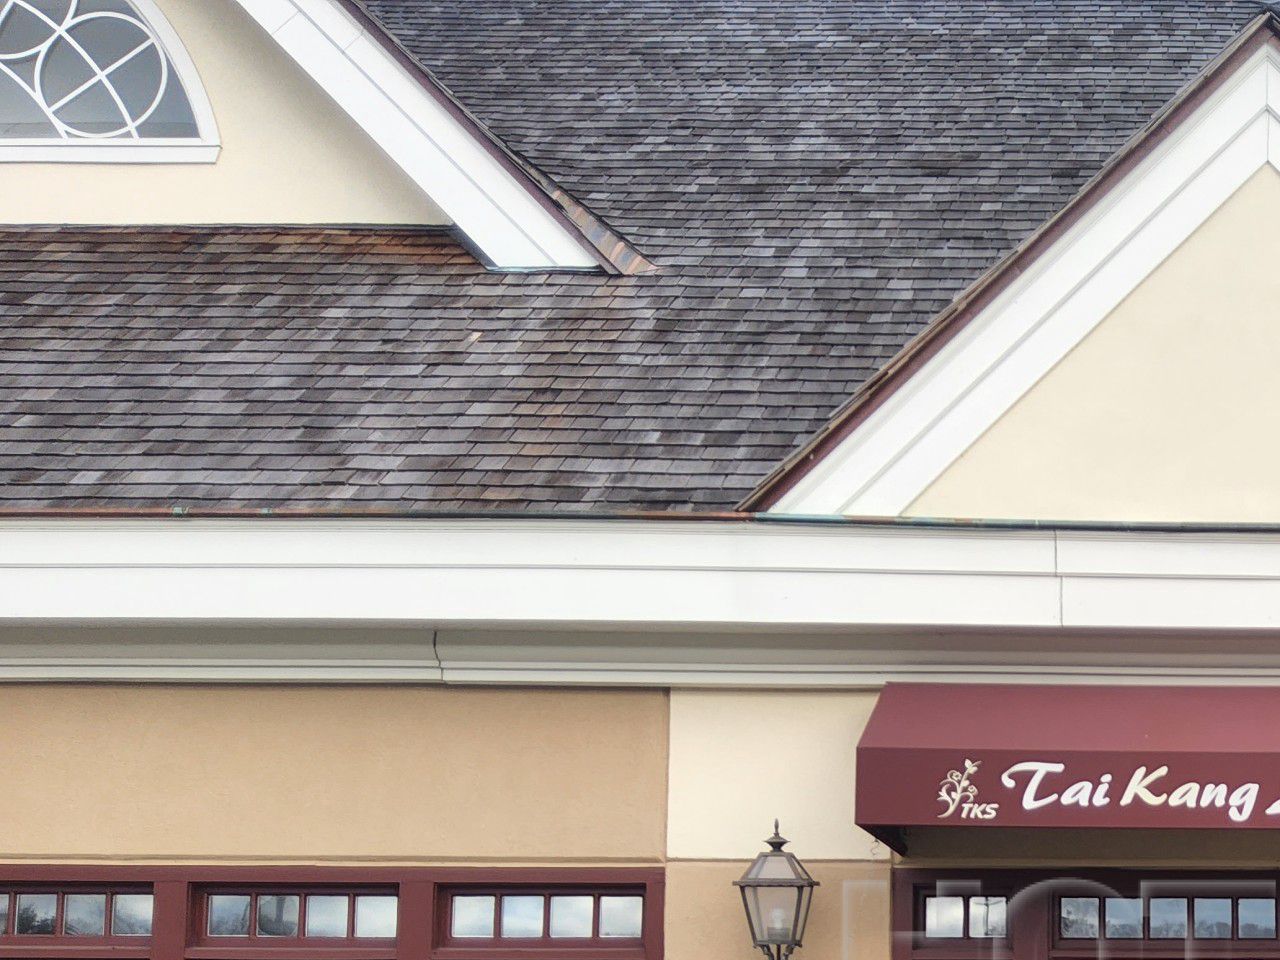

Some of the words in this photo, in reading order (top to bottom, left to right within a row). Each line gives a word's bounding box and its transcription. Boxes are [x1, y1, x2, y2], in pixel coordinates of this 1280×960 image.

[960, 802, 999, 820] TKS
[1002, 761, 1112, 810] Tai
[1120, 765, 1260, 823] Kang
